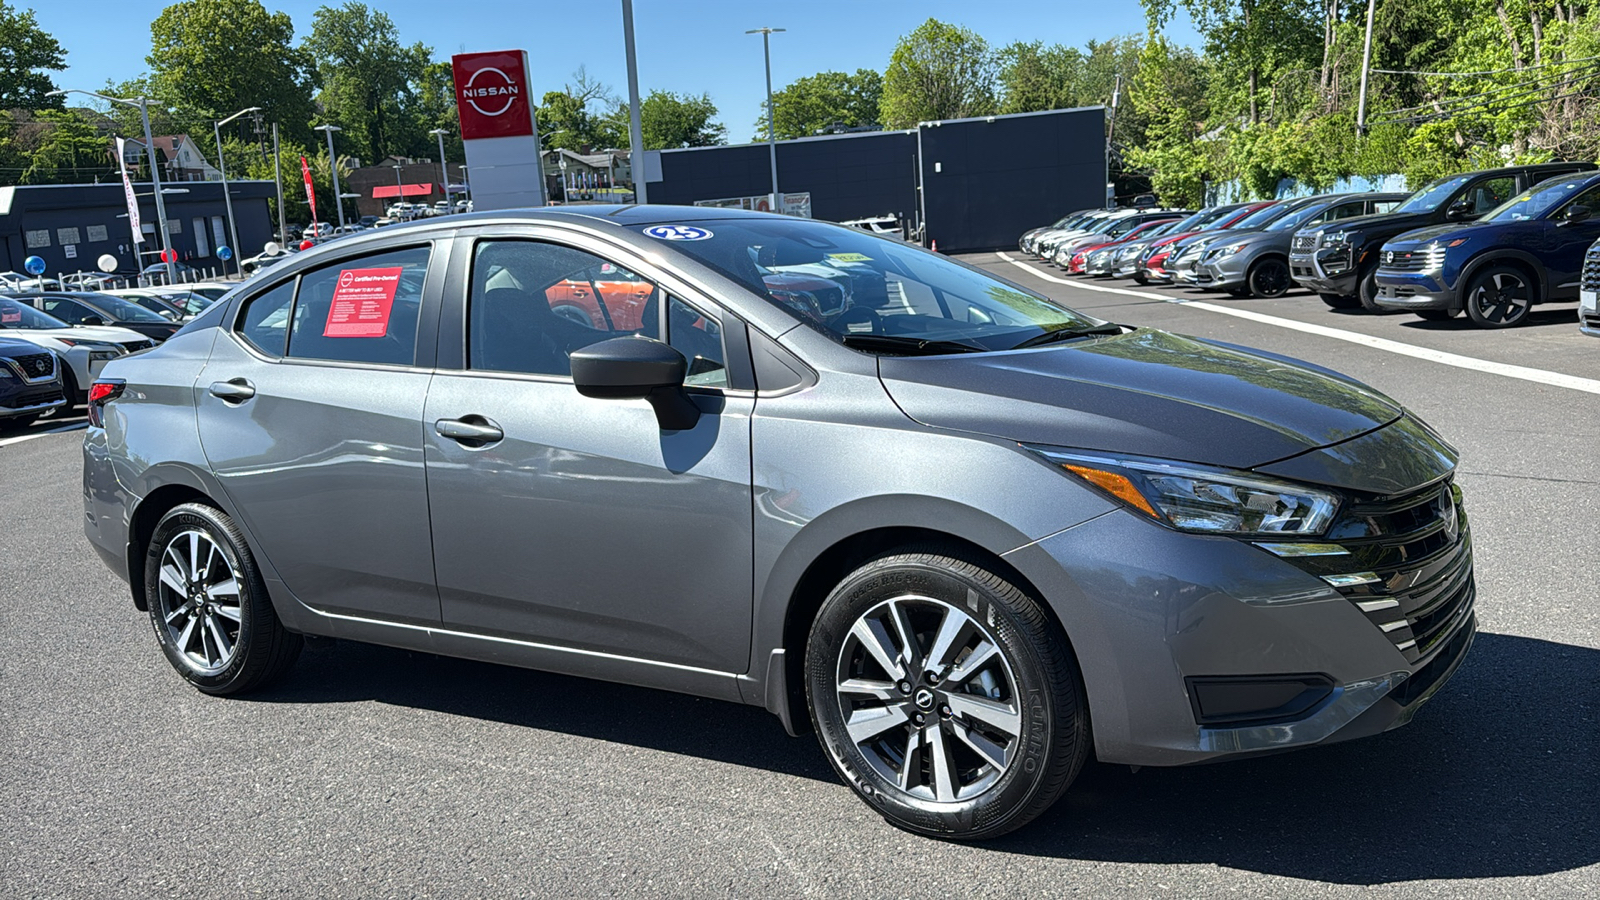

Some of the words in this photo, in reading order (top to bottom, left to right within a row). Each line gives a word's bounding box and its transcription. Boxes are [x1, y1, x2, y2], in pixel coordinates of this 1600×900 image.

[463, 86, 518, 98] NISSAN
[656, 226, 700, 239] 25
[178, 515, 213, 532] KUMHO
[847, 581, 879, 604] 205/55
[881, 575, 903, 586] R16
[1024, 688, 1043, 774] KUMHO
[832, 743, 886, 806] SOLUS
